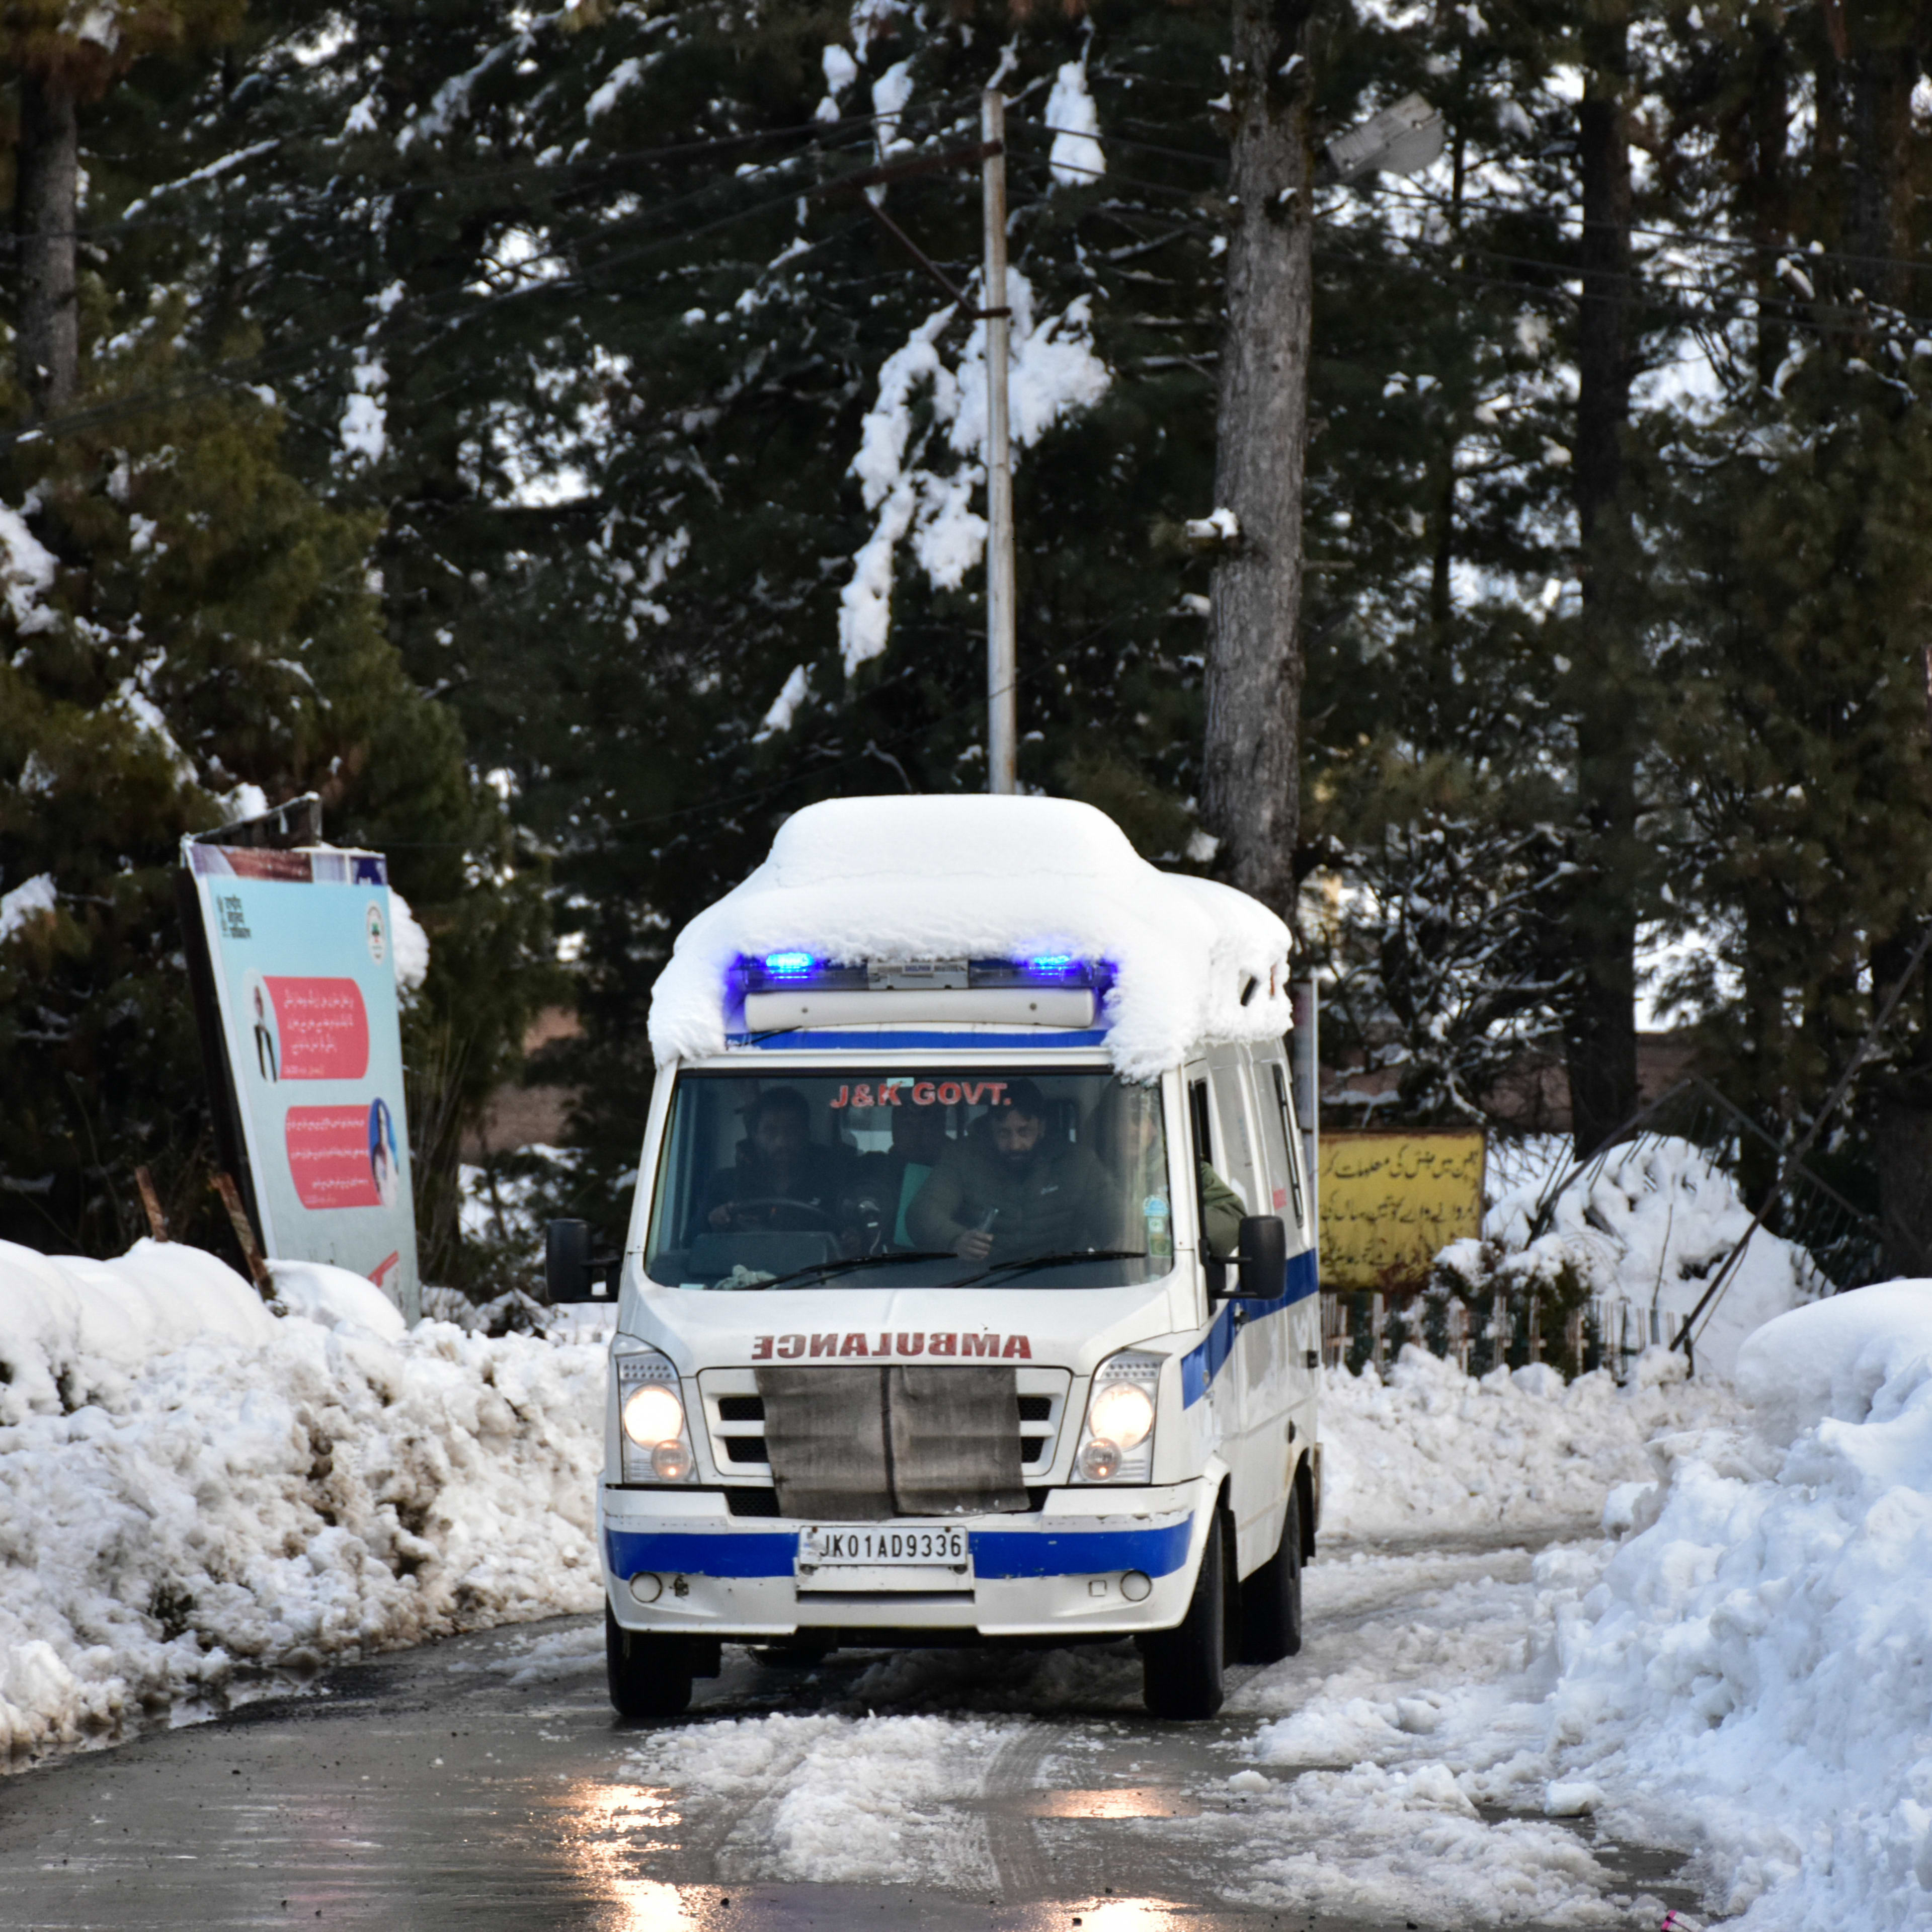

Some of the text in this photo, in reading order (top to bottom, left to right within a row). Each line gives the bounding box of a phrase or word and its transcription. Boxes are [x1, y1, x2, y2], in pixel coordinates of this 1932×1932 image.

[830, 1082, 1012, 1108] J&K GOVT.
[820, 1535, 961, 1557] JK01AD9336
